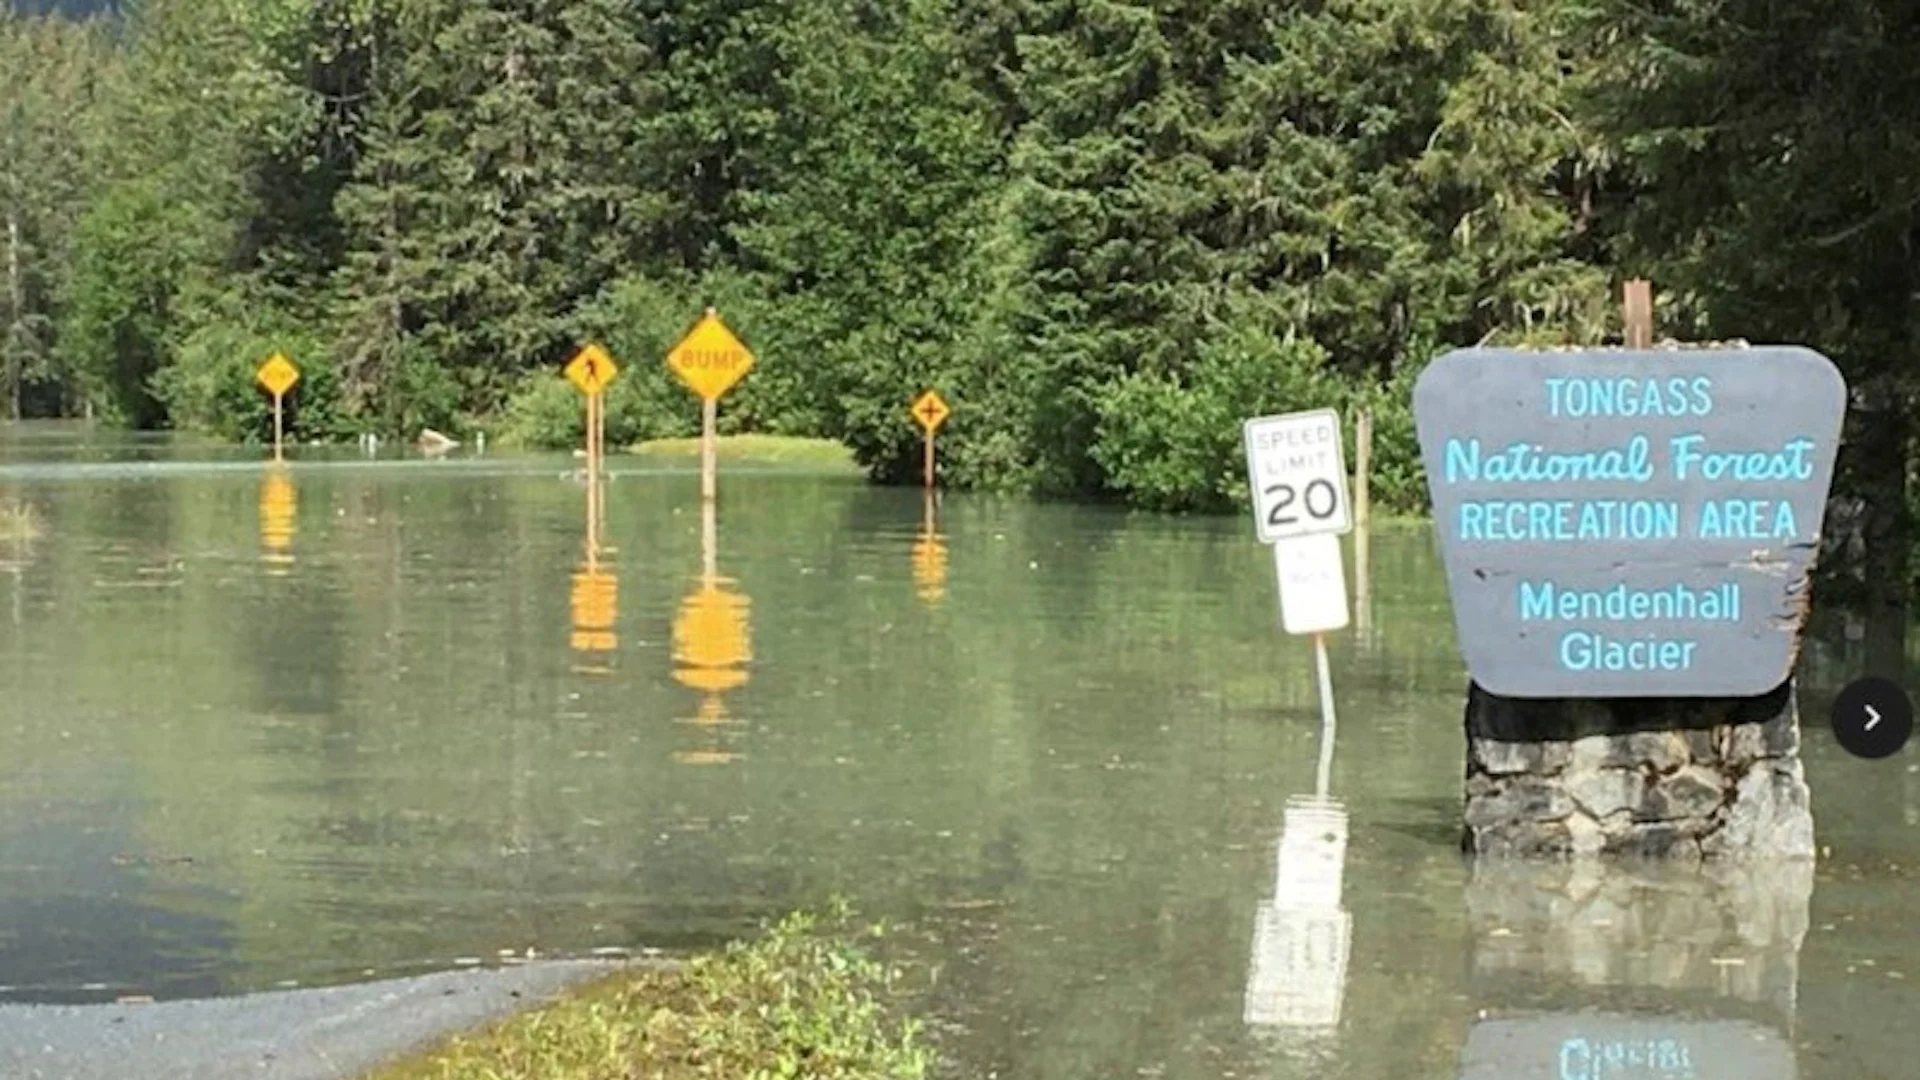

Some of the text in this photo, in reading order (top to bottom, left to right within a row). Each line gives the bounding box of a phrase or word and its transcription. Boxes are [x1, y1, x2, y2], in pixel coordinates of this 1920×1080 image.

[680, 348, 745, 370] BUMP
[1546, 377, 1713, 418] TONGASS
[1256, 425, 1331, 451] SPEED
[1266, 452, 1328, 476] LIMIT
[1443, 434, 1814, 483] National Forest
[1264, 478, 1338, 526] 20
[1459, 500, 1797, 540] RECREATION AREA
[1519, 581, 1741, 622] Mendenhall
[1560, 631, 1697, 671] Glacier
